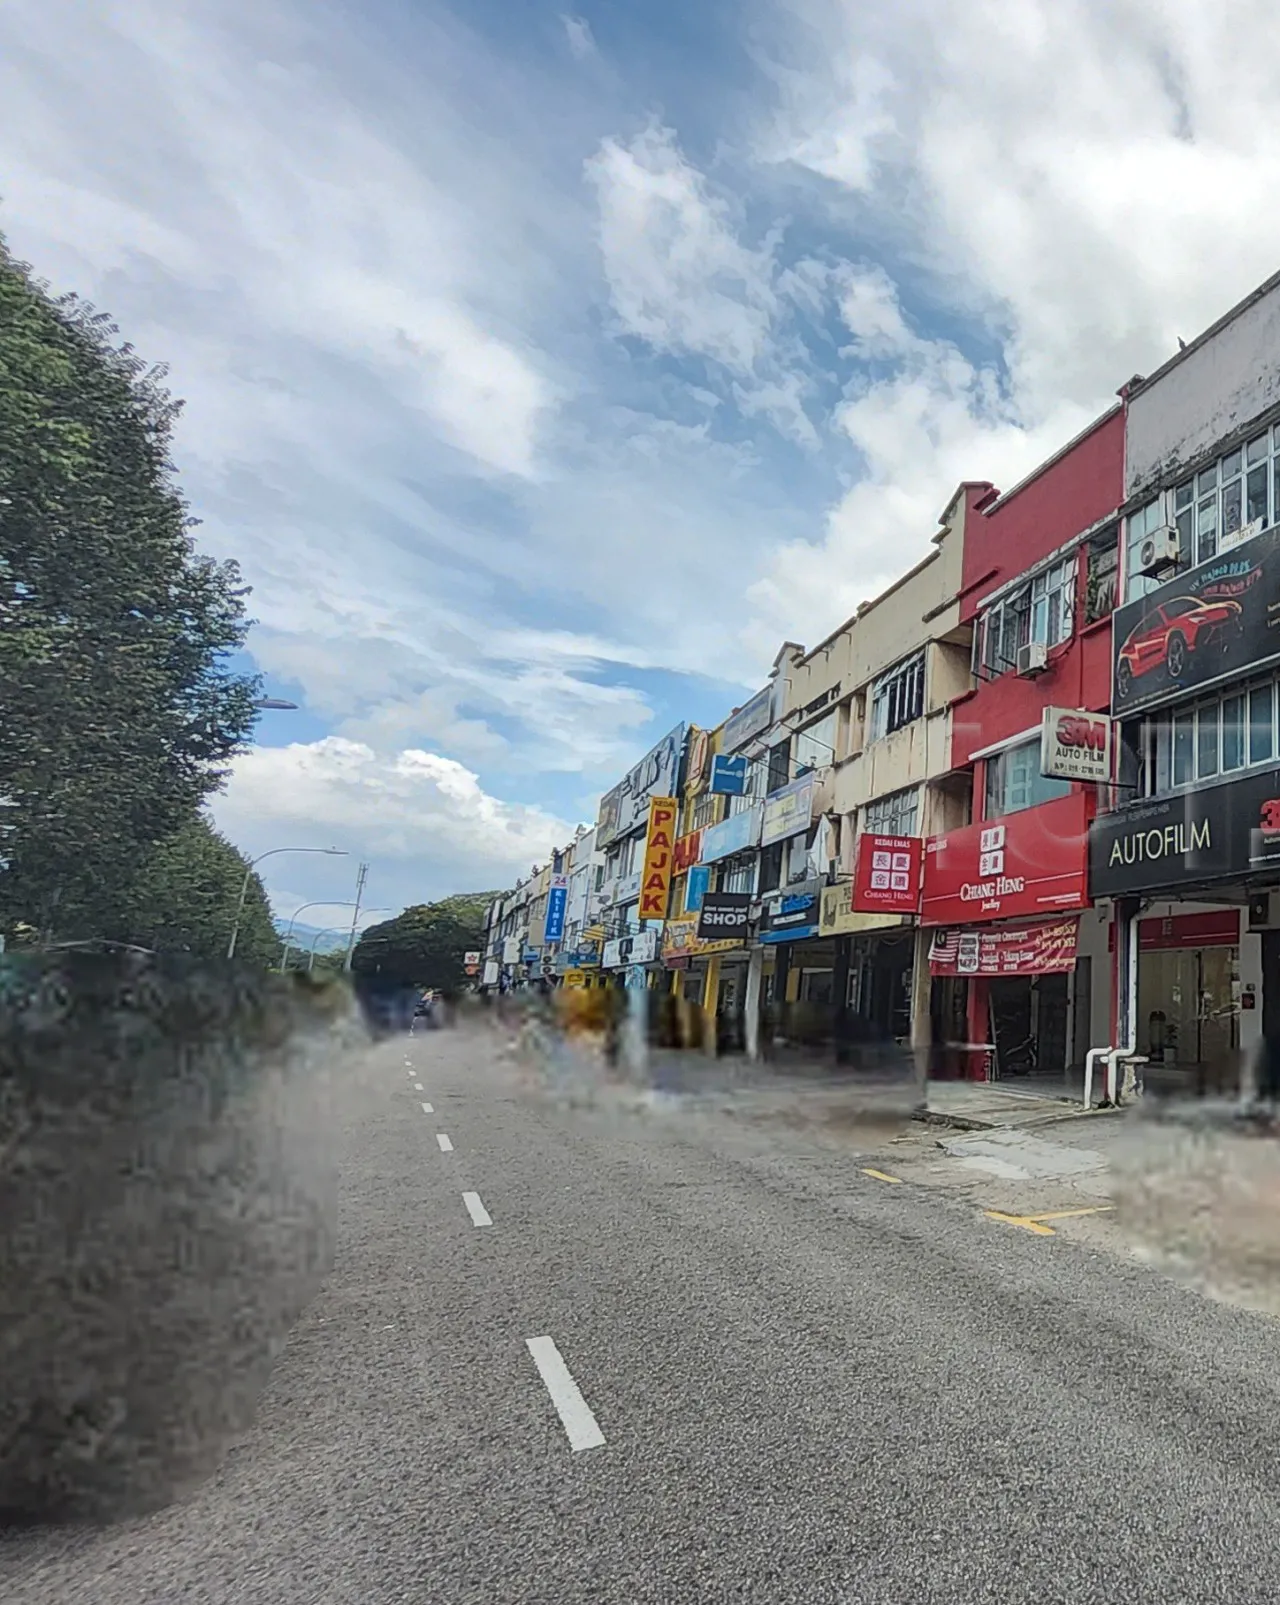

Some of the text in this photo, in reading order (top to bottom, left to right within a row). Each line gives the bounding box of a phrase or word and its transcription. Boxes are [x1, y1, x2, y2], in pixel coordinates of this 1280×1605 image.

[1056, 715, 1106, 752] 3M
[1055, 747, 1104, 762] AUTO FILM
[1108, 818, 1211, 868] AUTOFILM
[641, 810, 672, 912] PAJAK
[554, 876, 567, 884] 24
[996, 875, 1025, 896] HENG
[550, 890, 563, 934] KLINIK
[703, 912, 747, 925] SHOP
